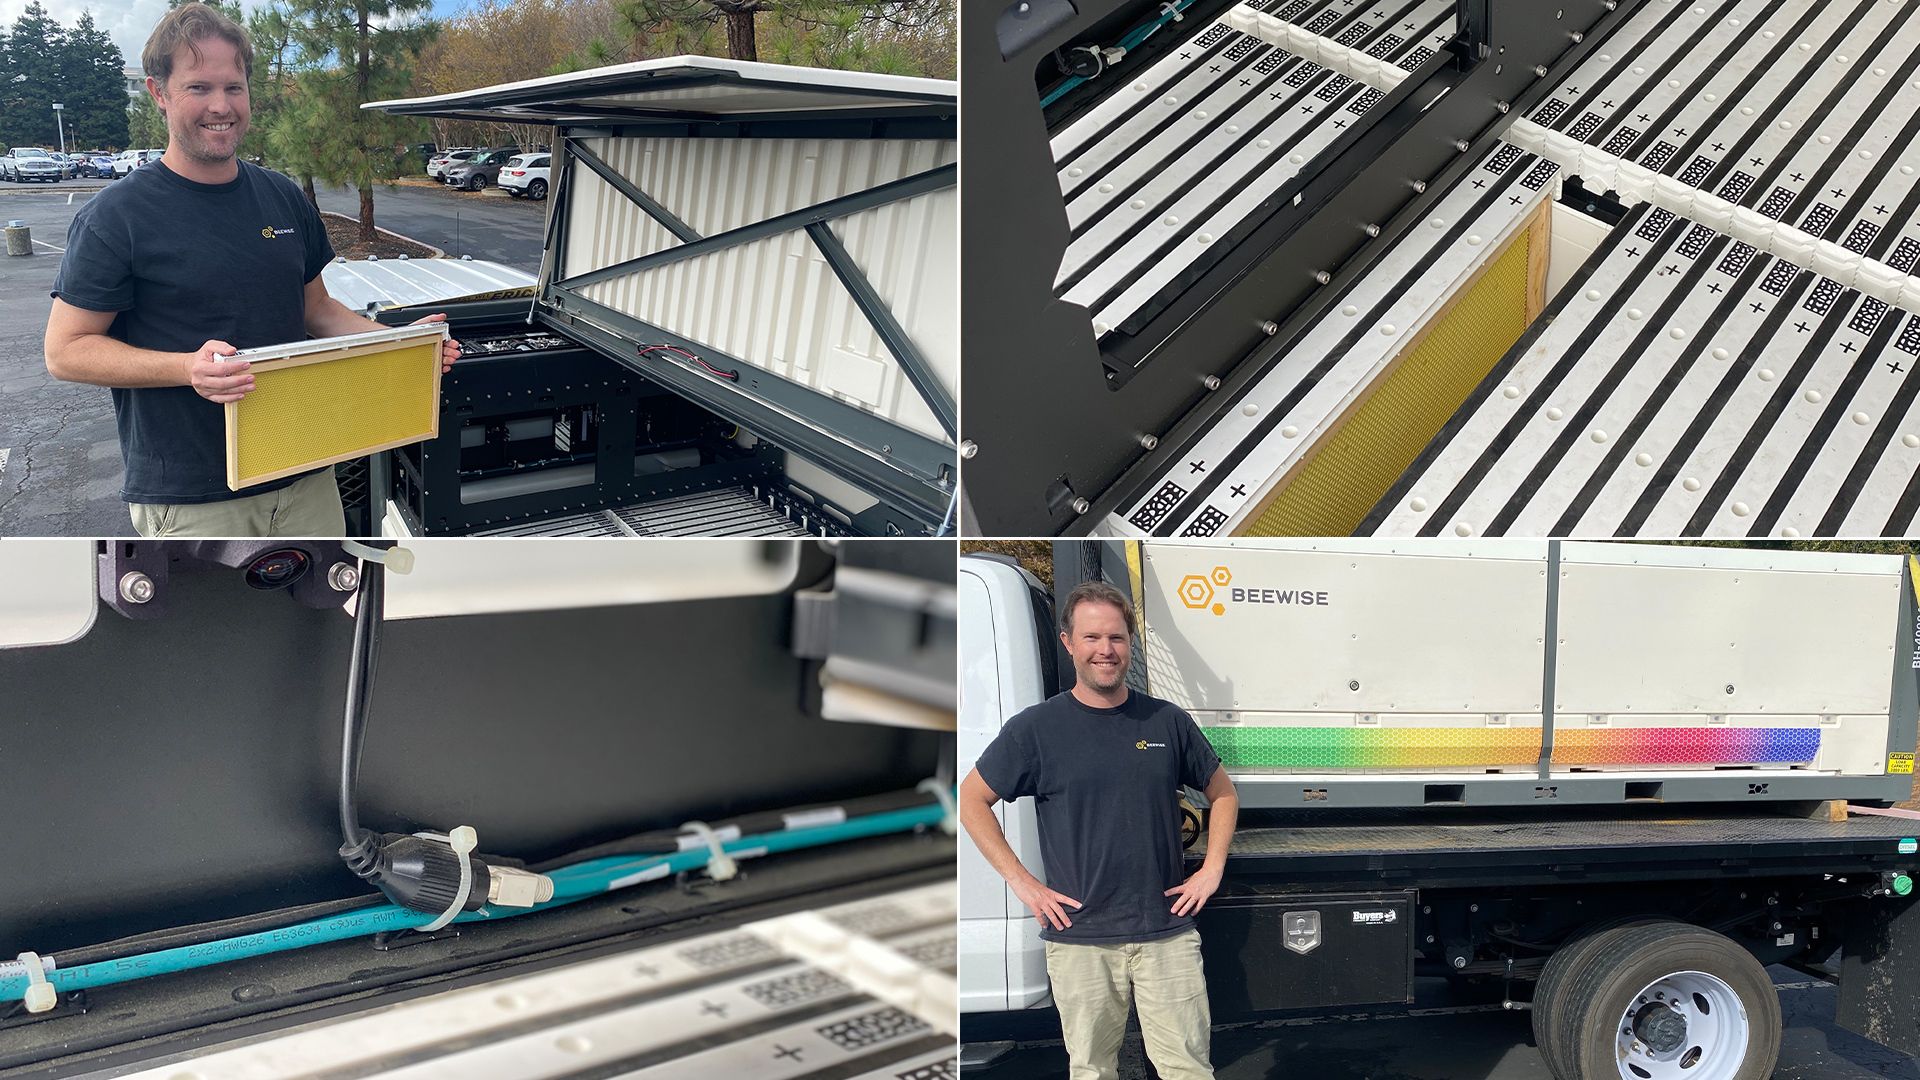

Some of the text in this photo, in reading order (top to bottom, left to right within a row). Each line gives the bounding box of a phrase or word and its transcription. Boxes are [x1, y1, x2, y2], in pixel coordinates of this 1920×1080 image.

[1231, 587, 1330, 607] BEEWISE
[1352, 911, 1384, 922] Buyers
[273, 924, 321, 943] E63634
[373, 911, 397, 925] AWM
